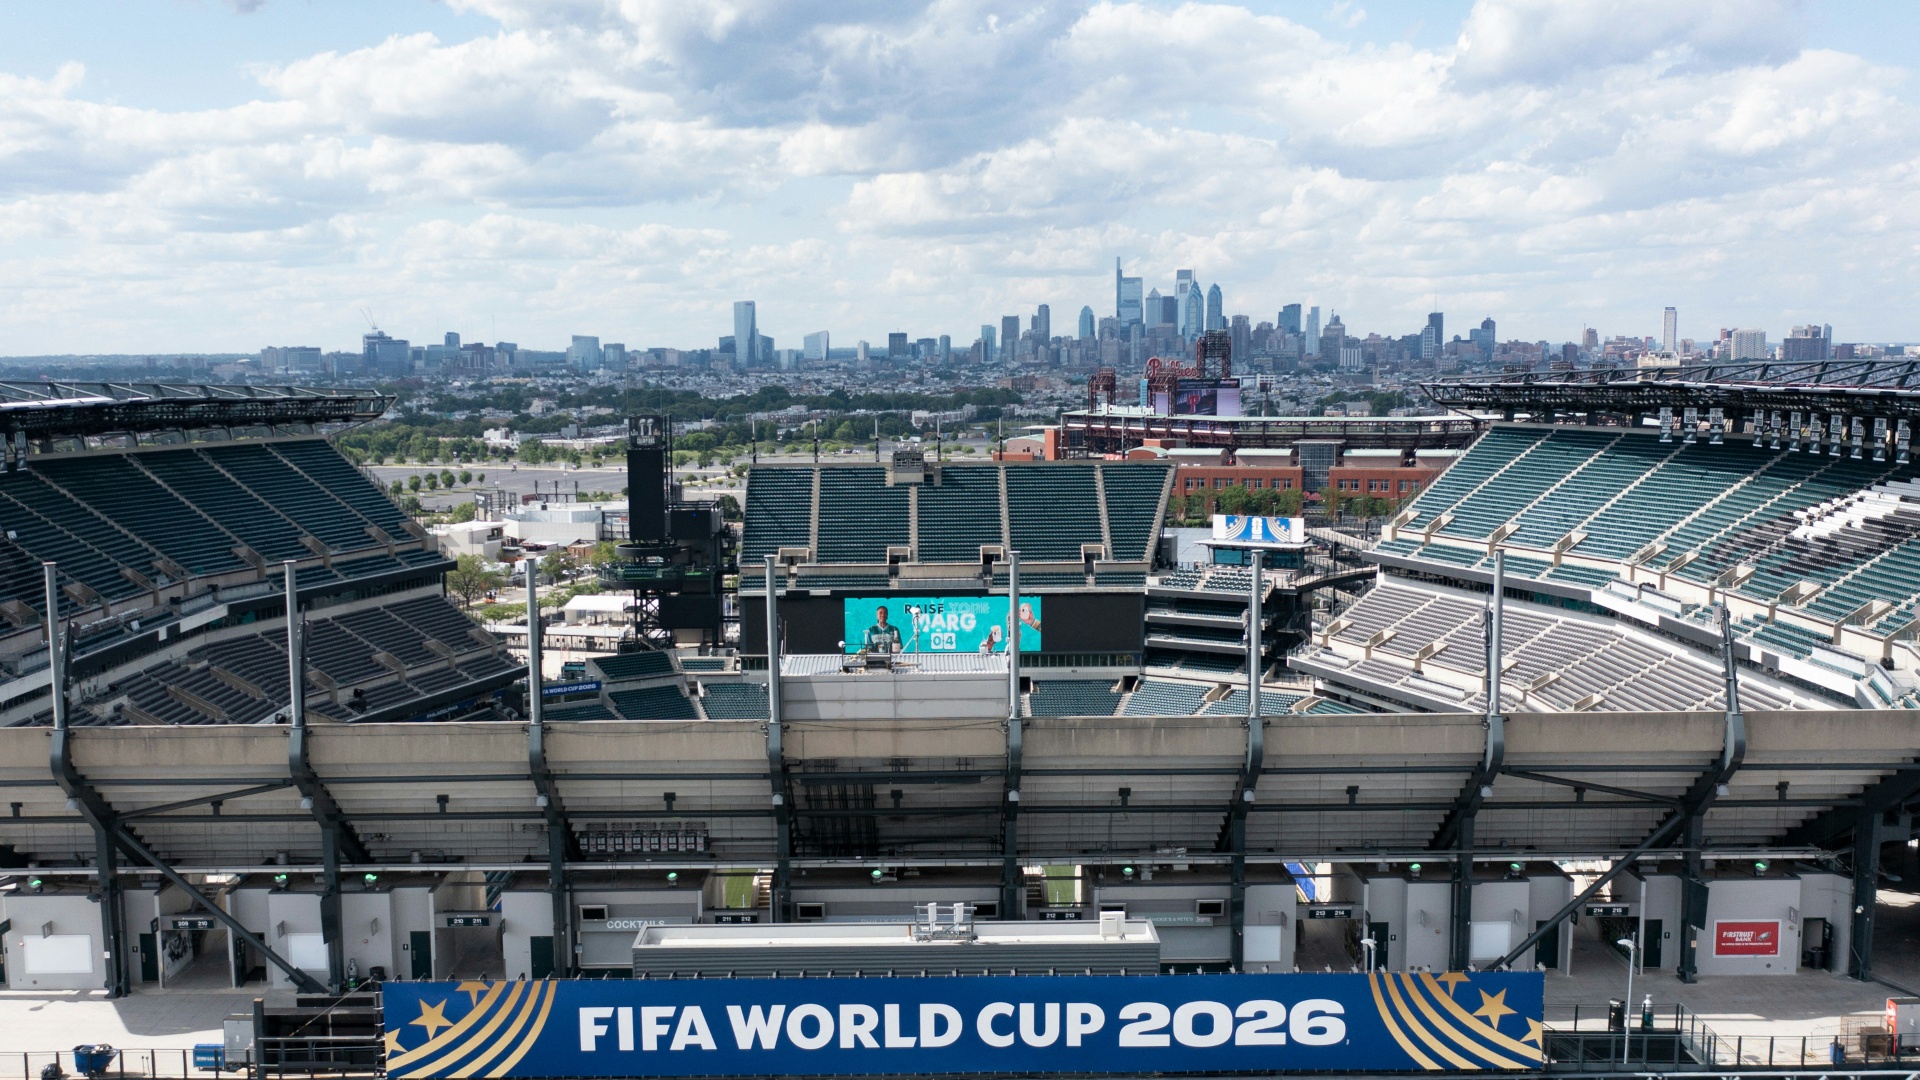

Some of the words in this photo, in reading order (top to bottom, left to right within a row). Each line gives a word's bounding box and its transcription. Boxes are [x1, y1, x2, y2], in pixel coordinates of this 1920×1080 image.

[912, 613, 977, 632] MARG
[932, 635, 954, 646] 04
[549, 686, 568, 694] WORLD
[606, 920, 665, 929] COCKTAILS
[578, 1005, 717, 1052] FIFA
[726, 1003, 963, 1050] WORLD
[976, 1001, 1106, 1048] CUP
[1118, 998, 1347, 1048] 2026
